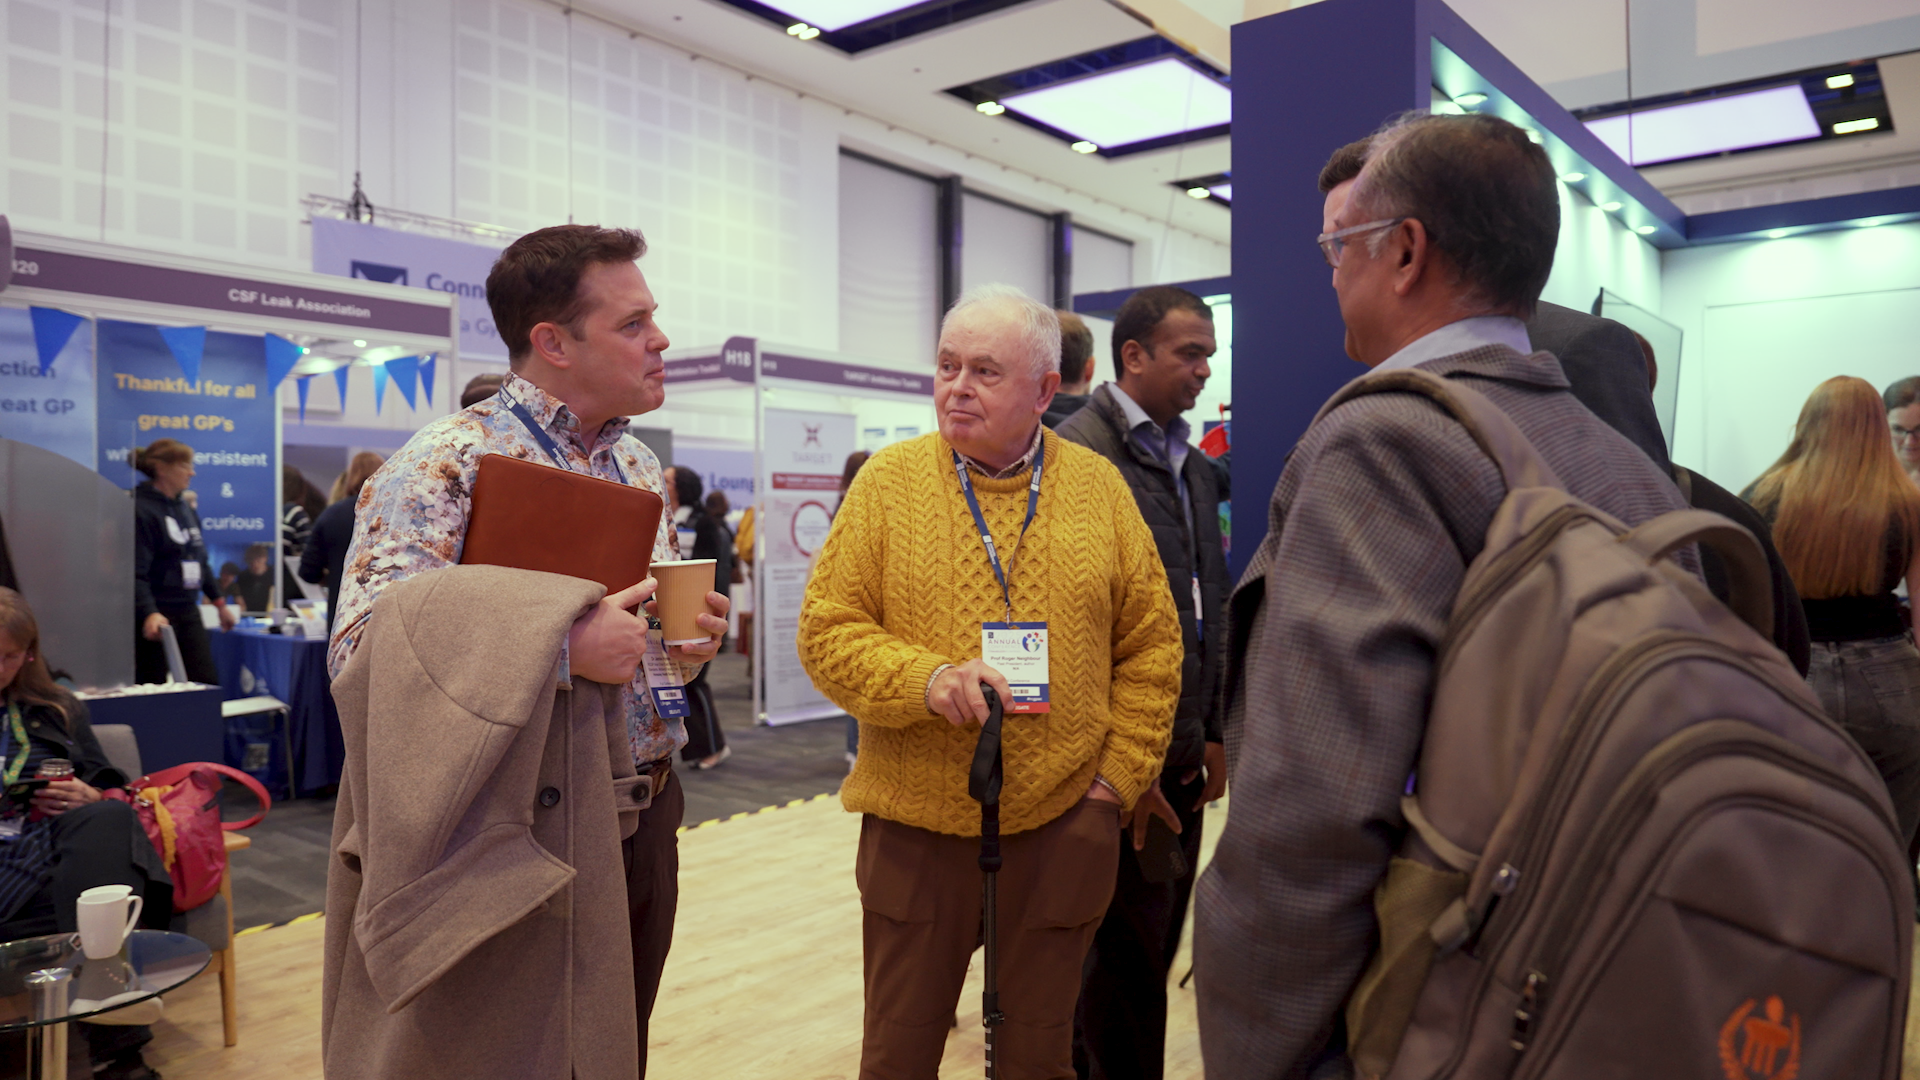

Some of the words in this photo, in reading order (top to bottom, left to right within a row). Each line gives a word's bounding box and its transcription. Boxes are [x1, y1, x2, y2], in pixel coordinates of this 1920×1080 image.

[228, 288, 258, 304] CSF
[261, 293, 294, 308] Leak
[296, 297, 371, 318] Association
[114, 373, 201, 395] Thankful
[205, 379, 232, 397] for
[235, 384, 257, 399] all
[0, 398, 37, 414] eat
[44, 398, 76, 415] GP
[137, 414, 190, 432] great
[193, 414, 235, 432] GP's
[193, 450, 268, 468] ersistent
[220, 482, 235, 499] &
[201, 514, 264, 531] curious
